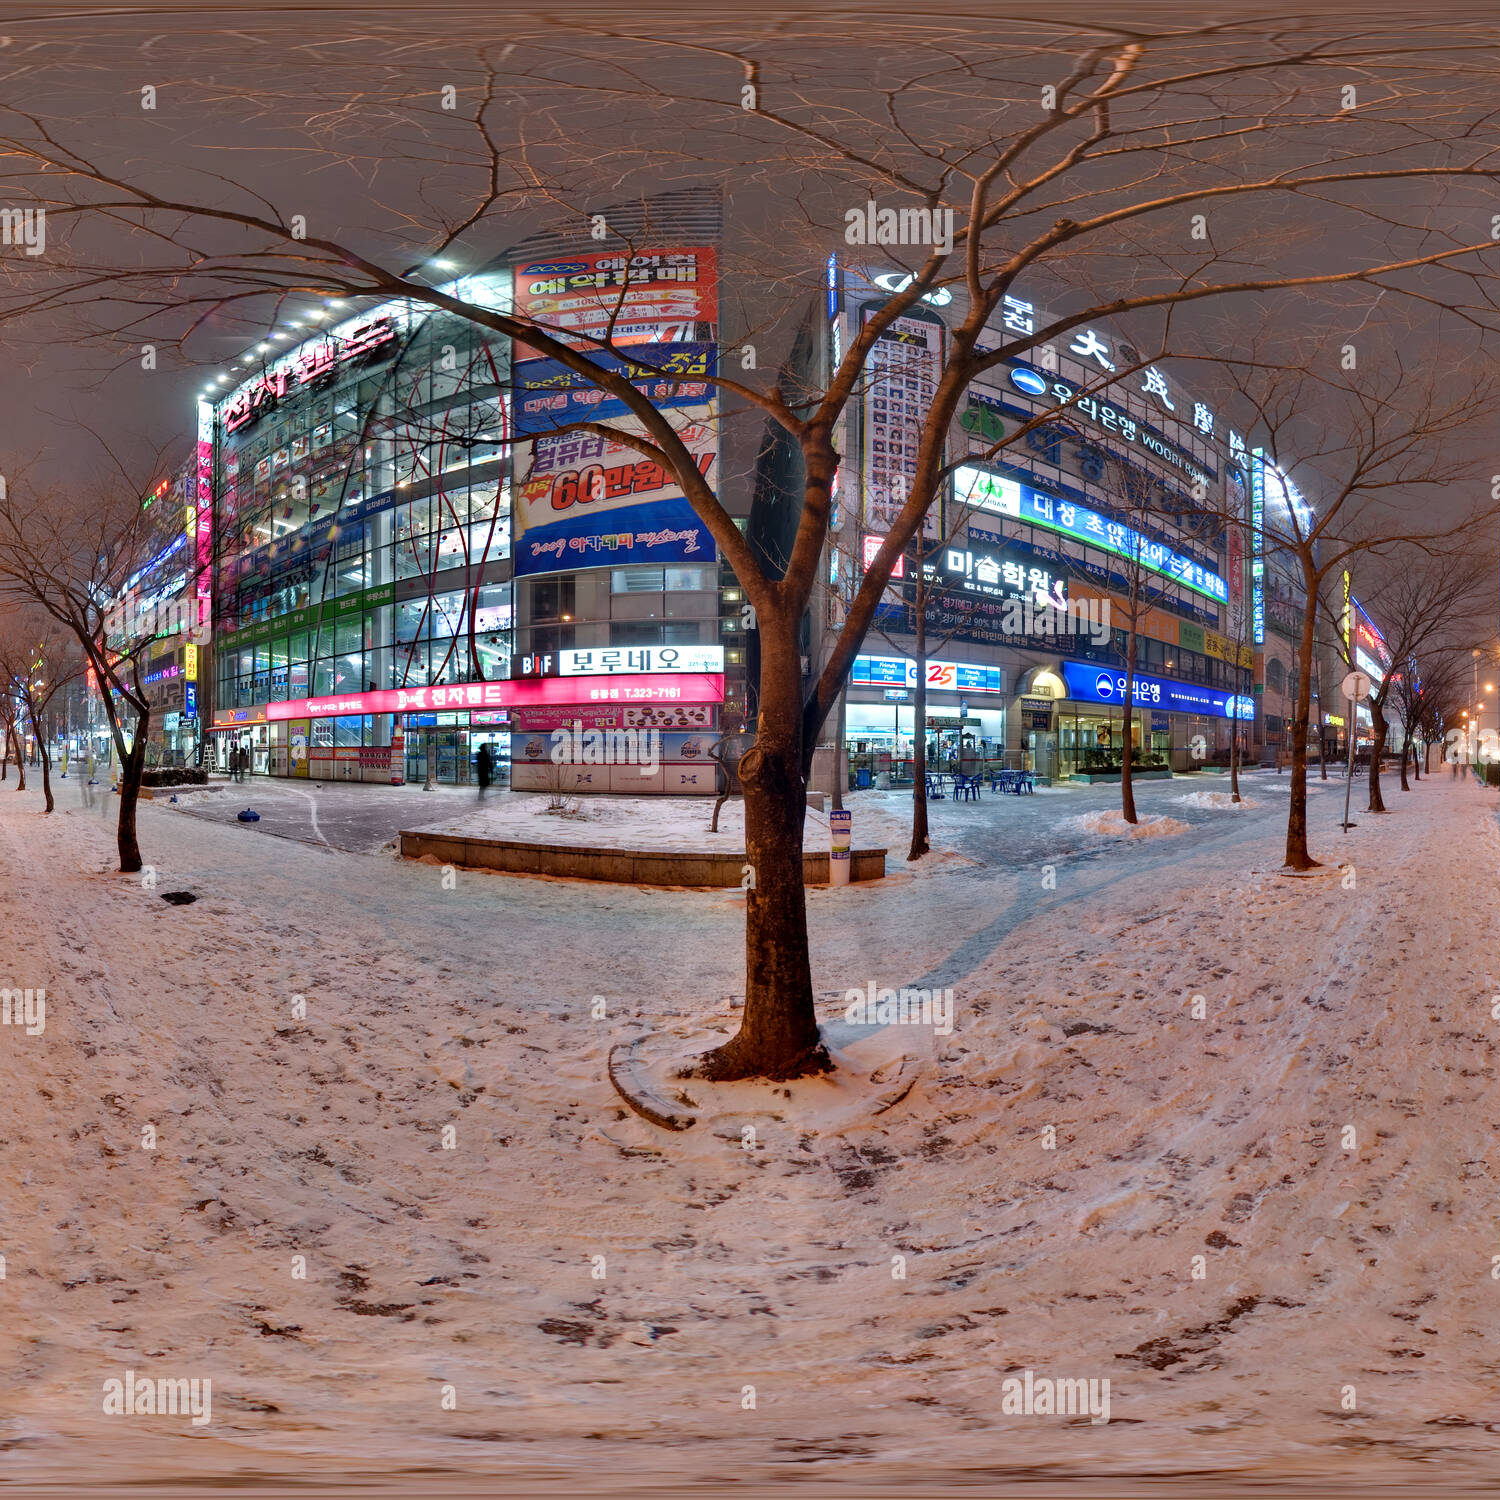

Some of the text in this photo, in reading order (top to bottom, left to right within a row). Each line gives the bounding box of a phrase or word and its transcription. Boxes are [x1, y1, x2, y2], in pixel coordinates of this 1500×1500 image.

[528, 266, 698, 296] 예약판매
[1003, 294, 1035, 336] 부천
[1050, 382, 1137, 442] 우리은행
[1140, 432, 1183, 468] WOORI
[1184, 464, 1211, 489] BANK
[533, 437, 604, 472] 컴퓨터
[1033, 493, 1076, 528] 대성
[530, 528, 701, 558] 2009 아카데미 페스티벌
[947, 549, 1050, 593] 미술학원
[571, 648, 682, 673] 보루네오
[909, 665, 956, 686] G25
[431, 685, 502, 706] 전자랜드
[624, 687, 682, 699] T.323-7161
